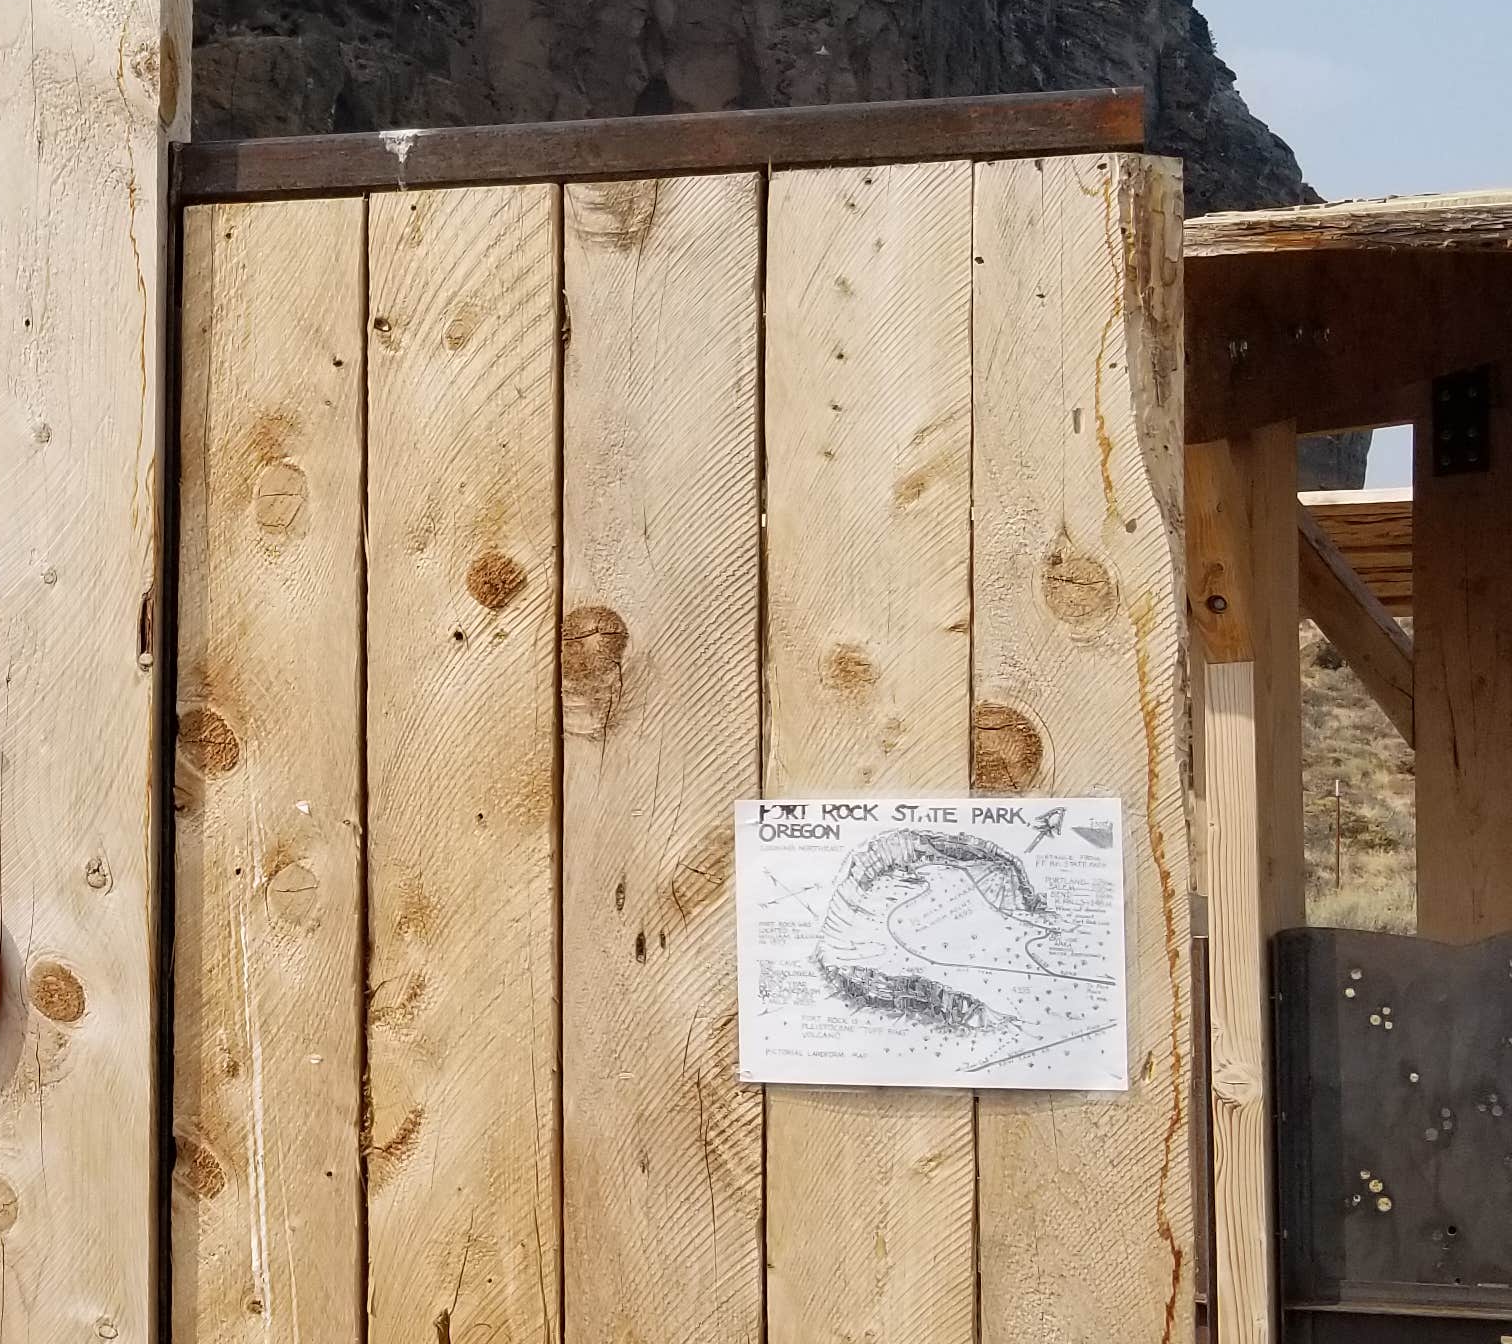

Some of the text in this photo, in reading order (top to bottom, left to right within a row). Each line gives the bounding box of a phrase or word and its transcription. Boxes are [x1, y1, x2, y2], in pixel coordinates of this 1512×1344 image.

[821, 803, 879, 822] ROCK
[971, 807, 1031, 827] PARK,
[759, 823, 840, 842] OREGON
